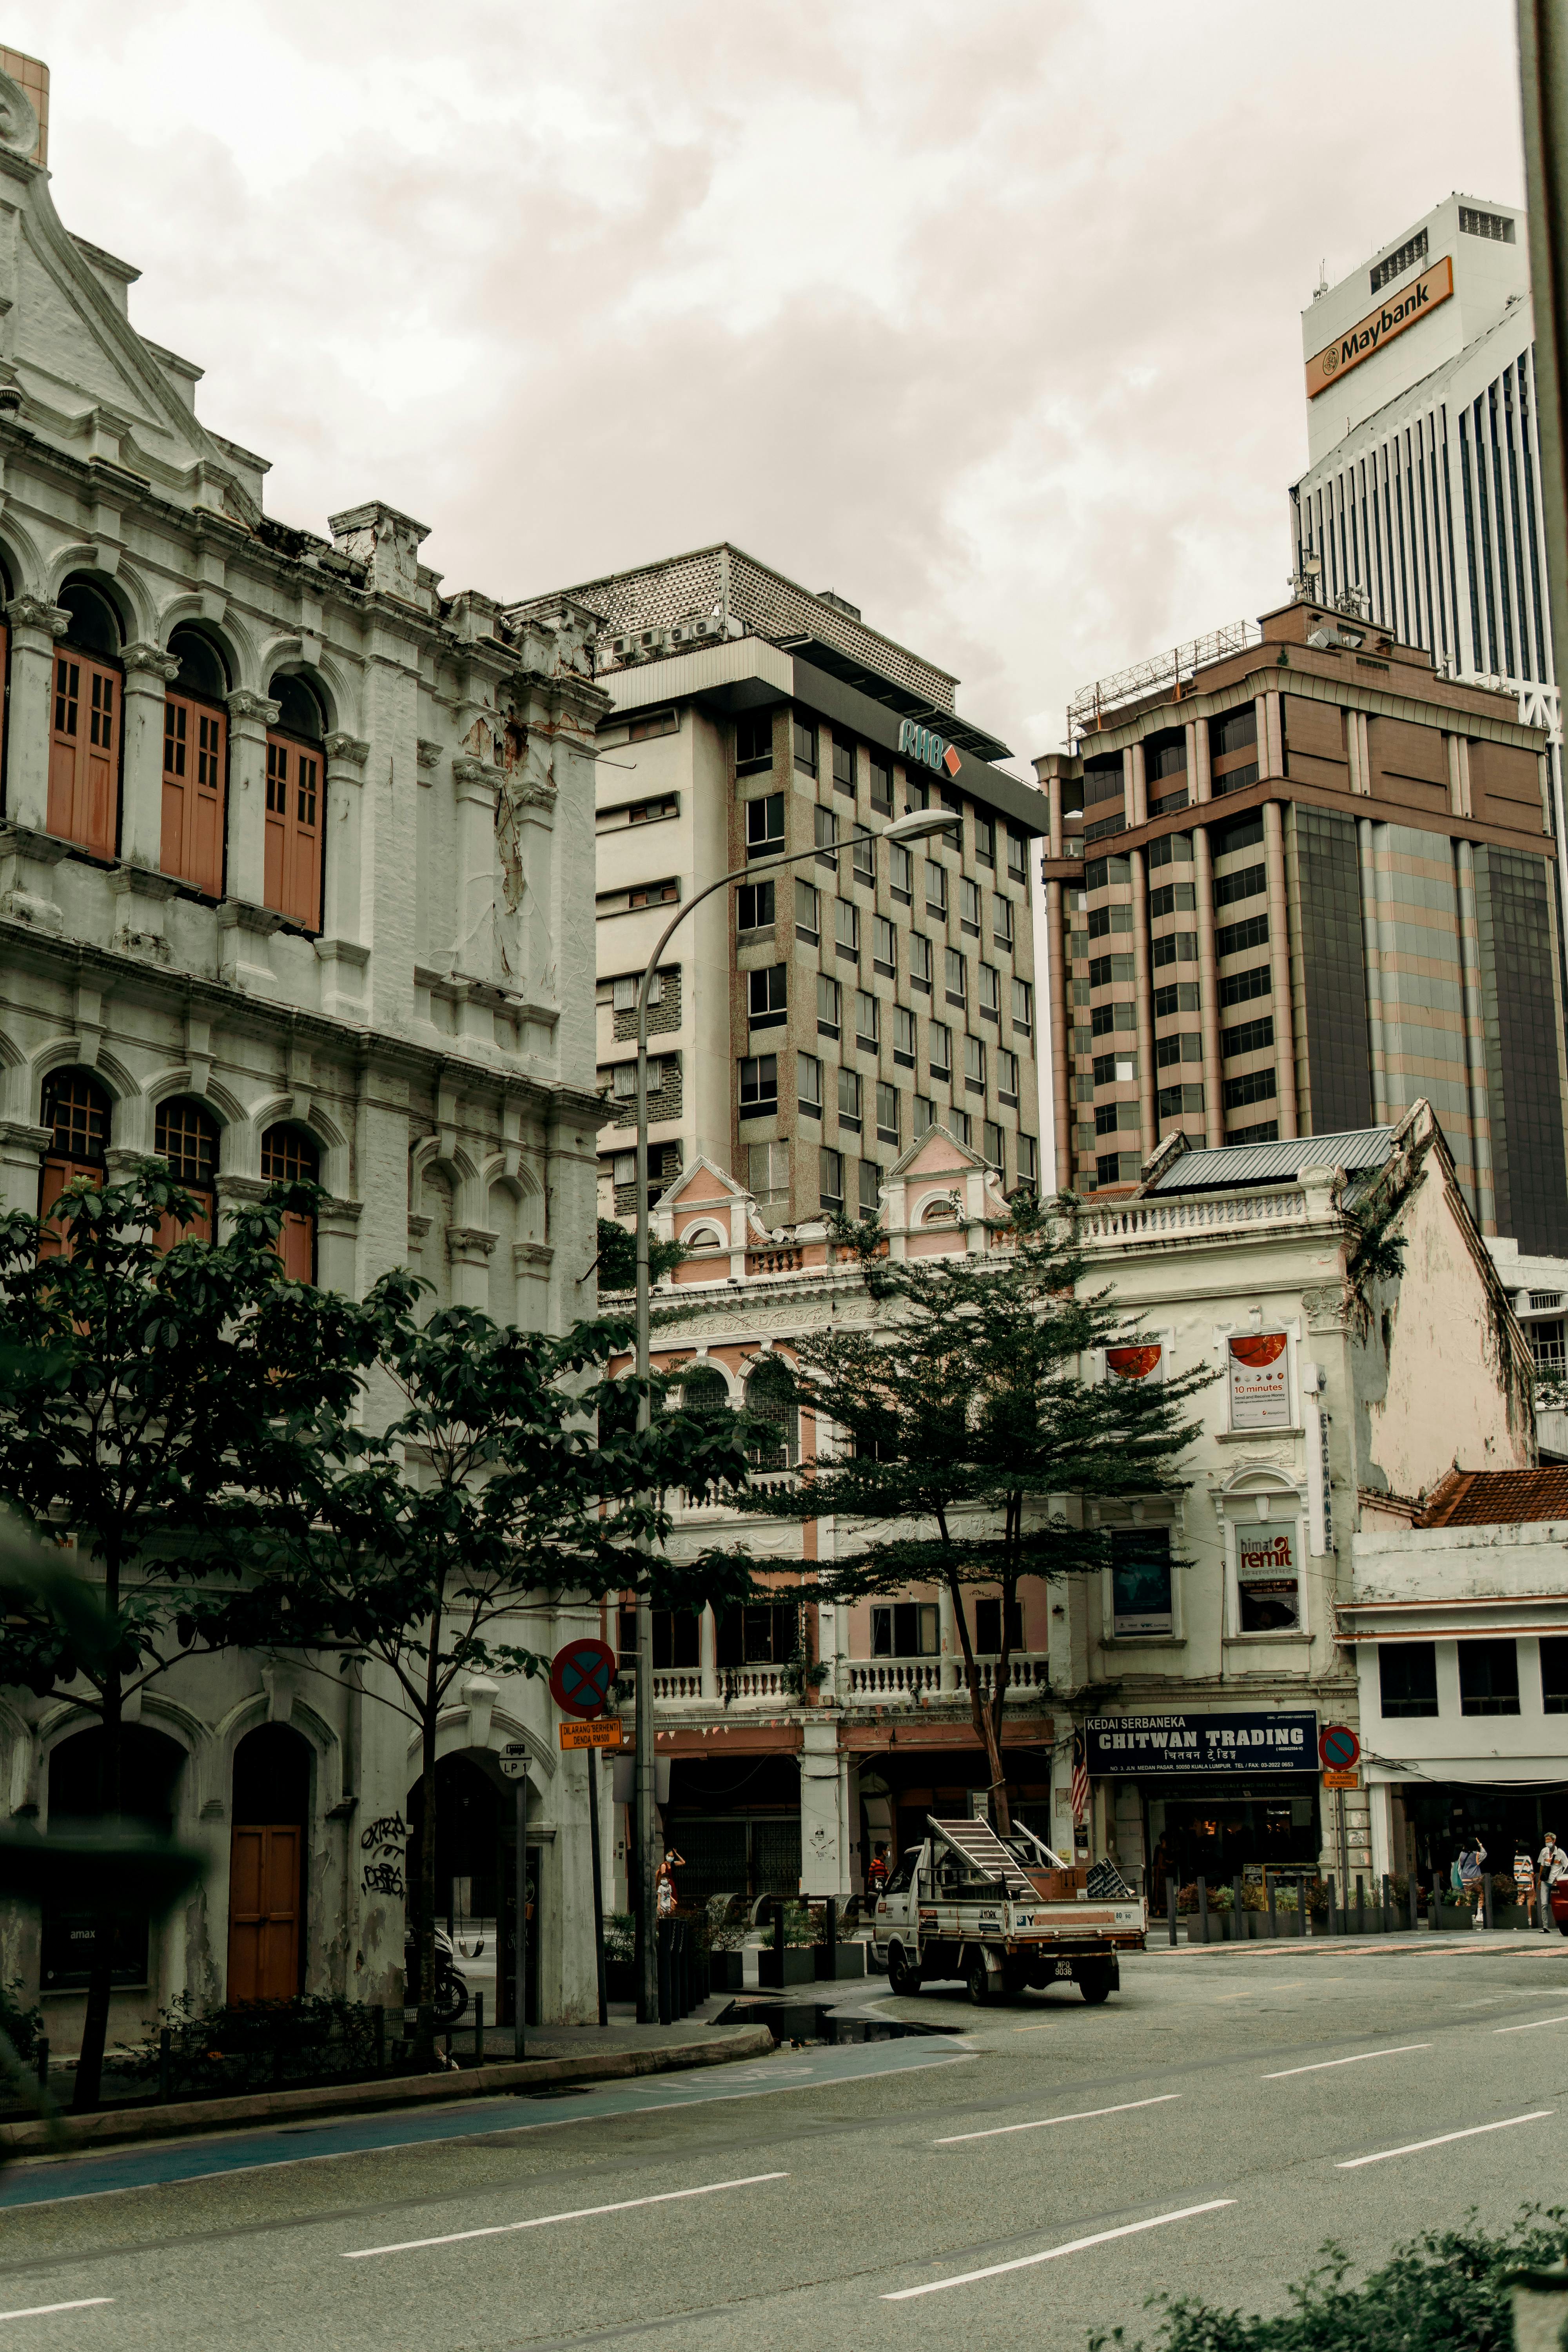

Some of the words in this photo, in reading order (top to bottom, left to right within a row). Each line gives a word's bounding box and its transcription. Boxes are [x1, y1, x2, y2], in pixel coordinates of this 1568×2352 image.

[1341, 283, 1429, 365] Maybank
[898, 719, 943, 770] RHB
[1247, 1384, 1282, 1392] minutes
[1320, 1413, 1332, 1551] EXCHANGE
[1241, 1544, 1292, 1568] remit
[563, 1725, 590, 1735] DILARANG
[592, 1723, 618, 1732] BERHENTI
[1087, 1719, 1118, 1730] KEDAI
[1122, 1717, 1186, 1729] SERBANEKA
[573, 1736, 591, 1744] DENDA
[593, 1734, 609, 1742] RM500
[1099, 1731, 1197, 1749] CHITWAN
[1205, 1728, 1303, 1746] TRADING
[504, 1763, 517, 1772] LP
[523, 1763, 526, 1772] 1
[984, 1910, 998, 1919] YORK
